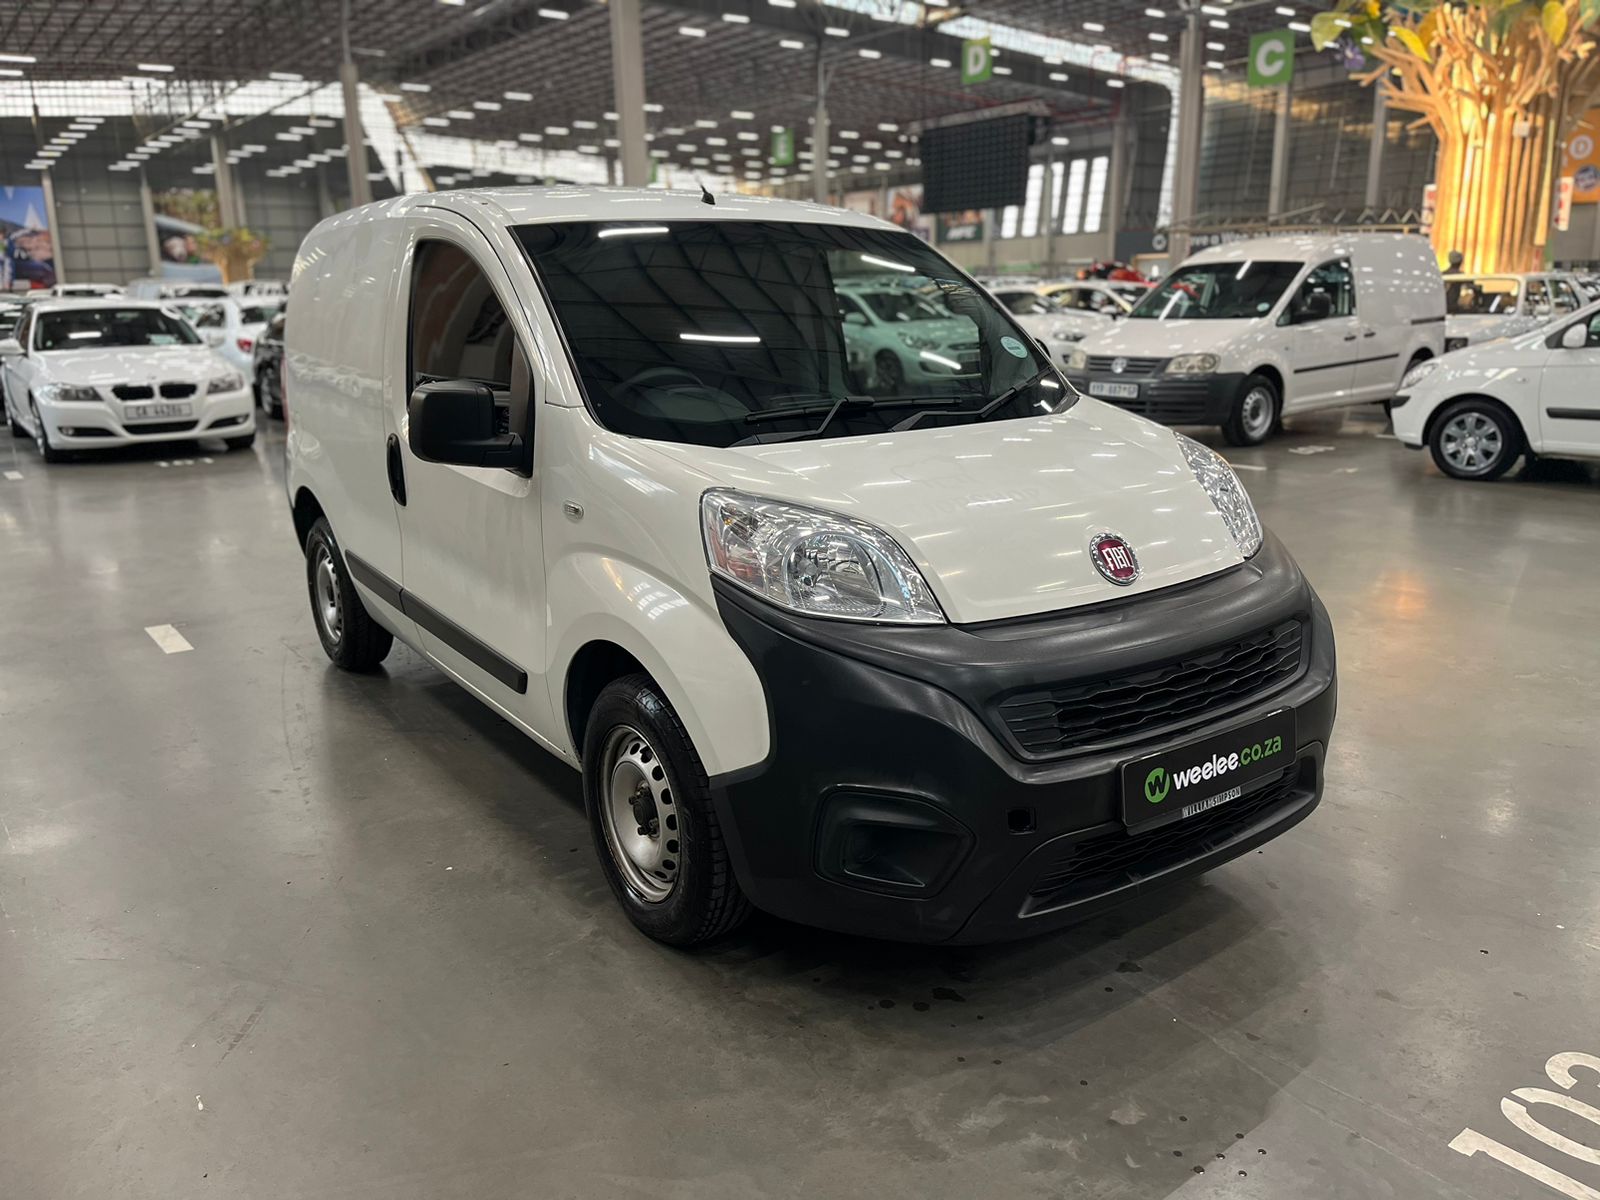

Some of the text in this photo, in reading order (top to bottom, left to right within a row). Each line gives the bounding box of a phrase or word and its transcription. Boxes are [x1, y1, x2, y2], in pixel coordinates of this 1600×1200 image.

[967, 45, 987, 77] D
[1256, 39, 1286, 77] C
[1102, 546, 1131, 571] FIAT
[1173, 735, 1283, 791] weelee.co.za
